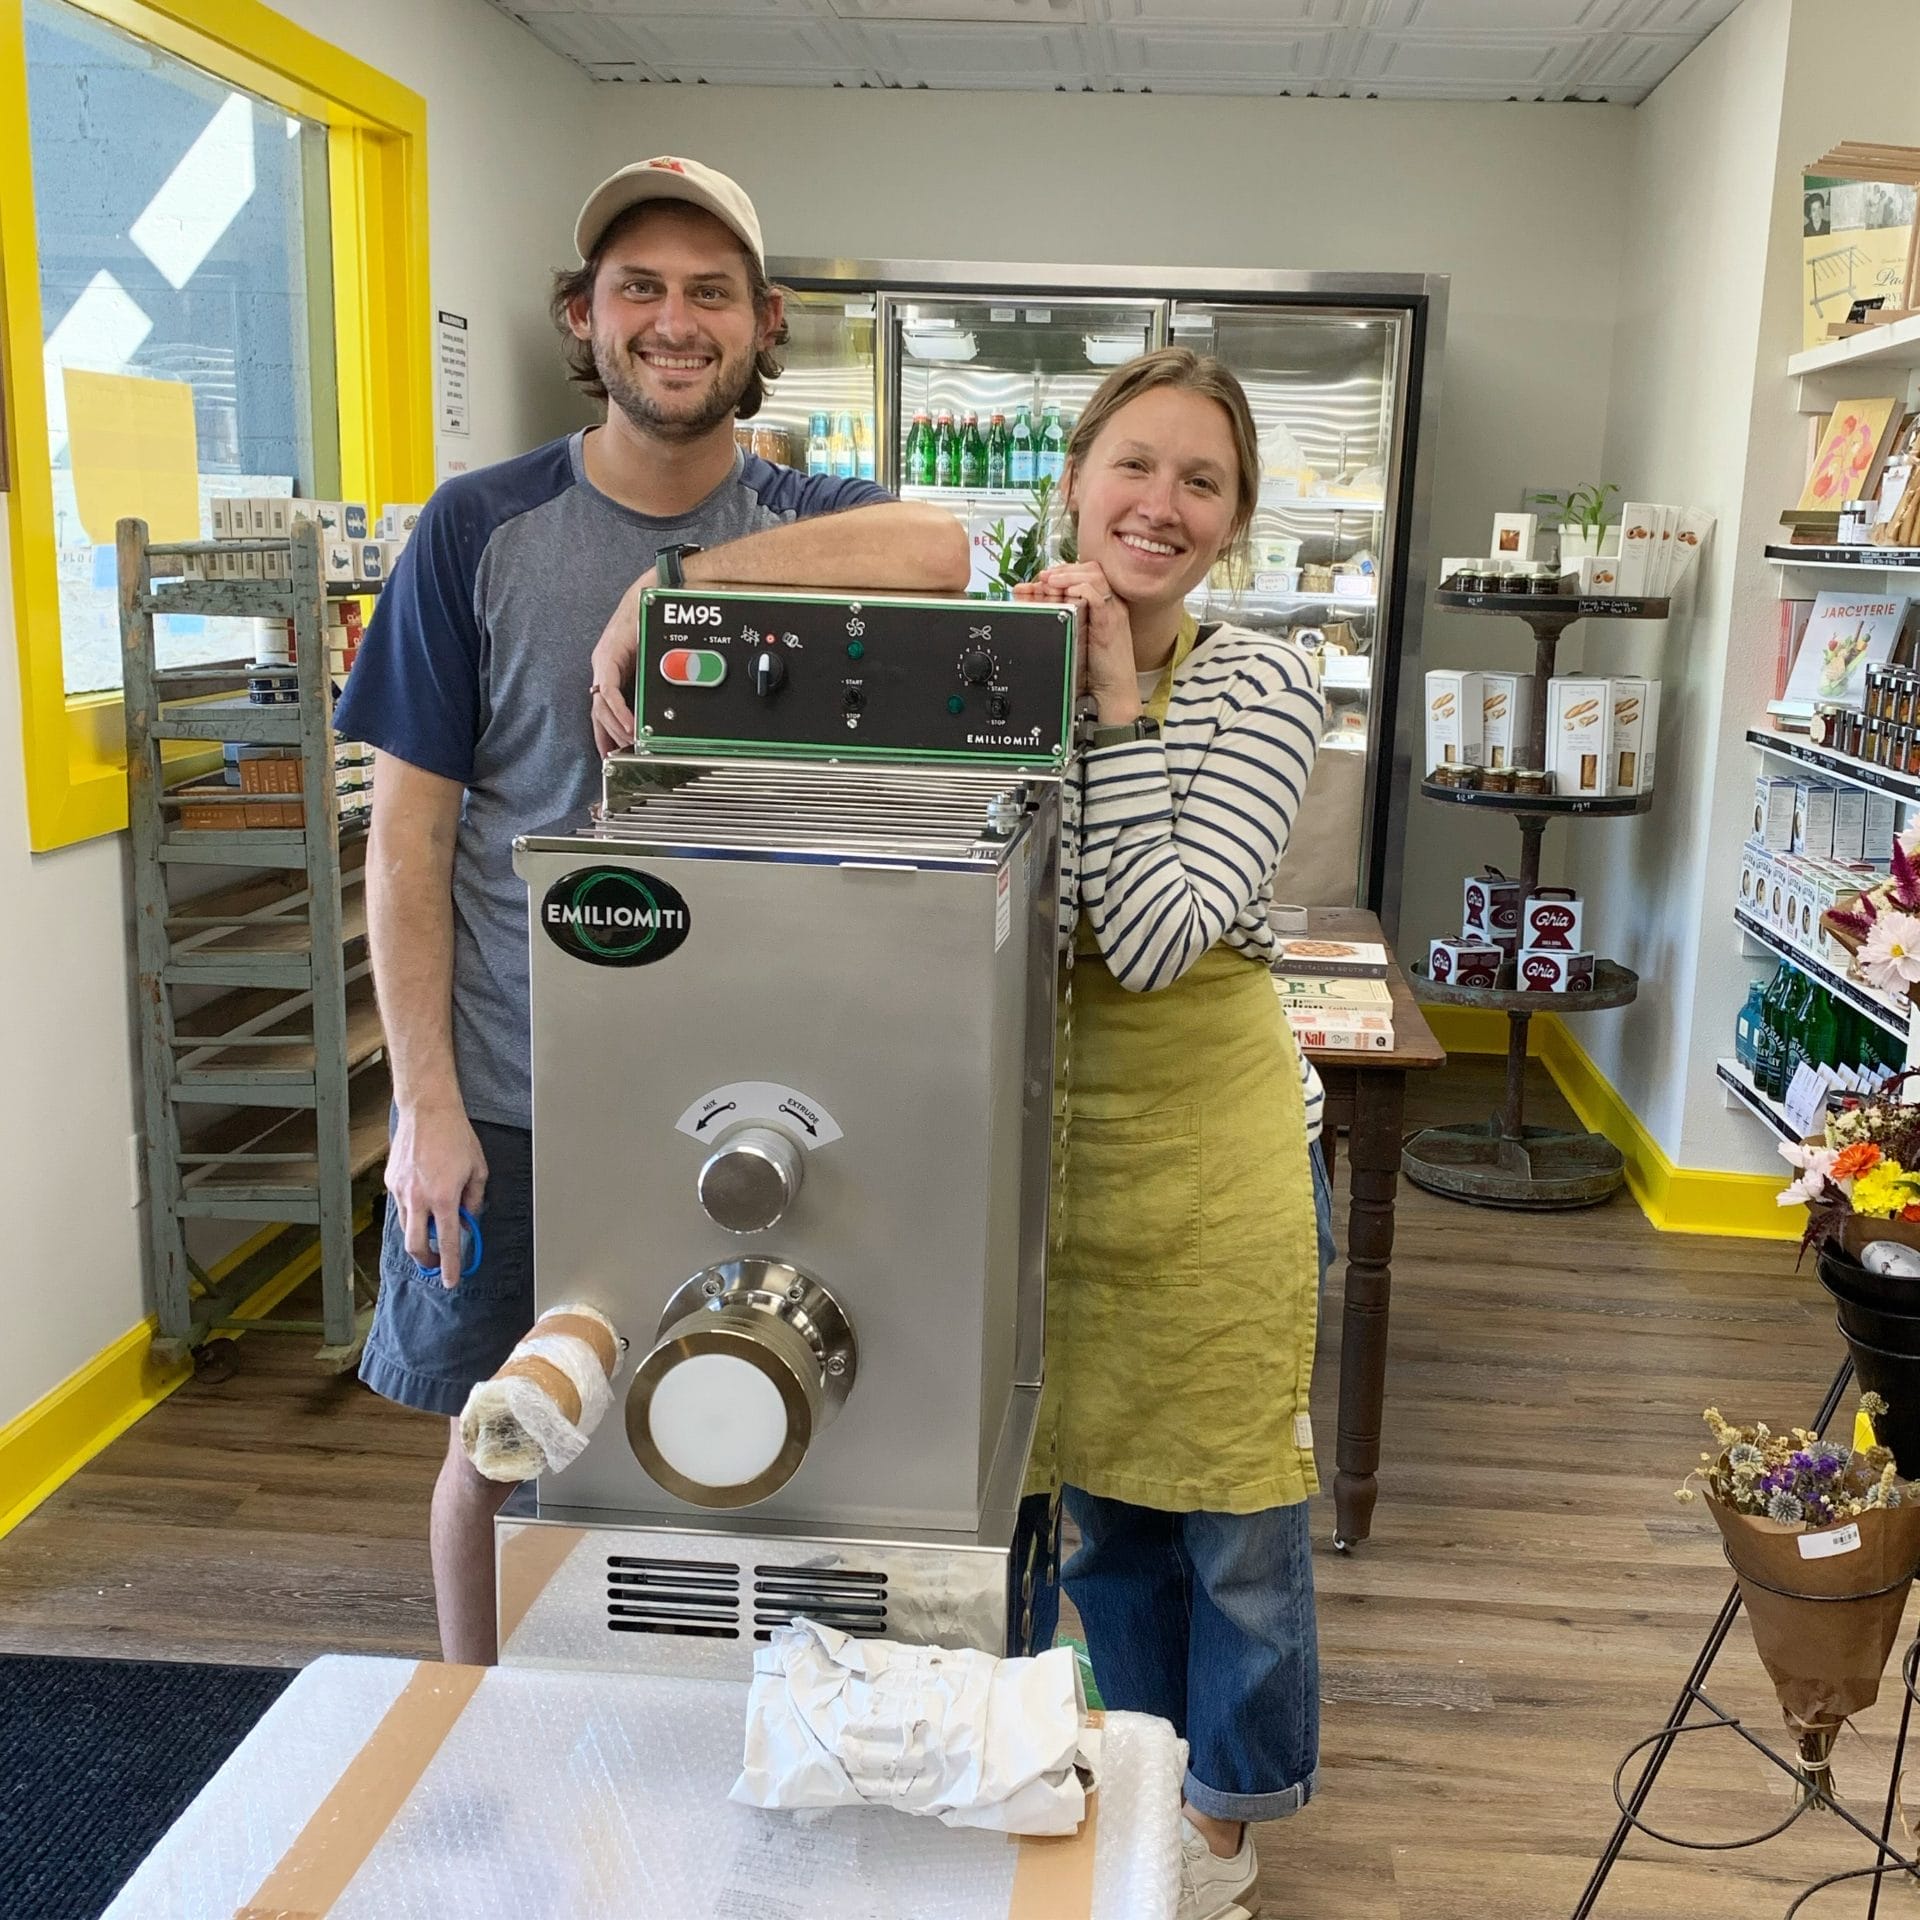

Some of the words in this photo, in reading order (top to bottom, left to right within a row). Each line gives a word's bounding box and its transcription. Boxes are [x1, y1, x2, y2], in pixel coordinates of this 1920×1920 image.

[664, 603, 722, 626] EM95
[669, 634, 689, 642] STOP
[709, 636, 732, 644] START
[967, 734, 1040, 746] EMILIOMITI
[547, 904, 684, 929] EMILIOMITI
[1536, 911, 1570, 927] Ghia
[1304, 964, 1335, 972] ITALIAN
[1526, 962, 1556, 979] Ghia
[1304, 1031, 1326, 1046] Salt
[702, 1099, 719, 1112] MIX
[786, 1097, 820, 1125] EXTRUDE
